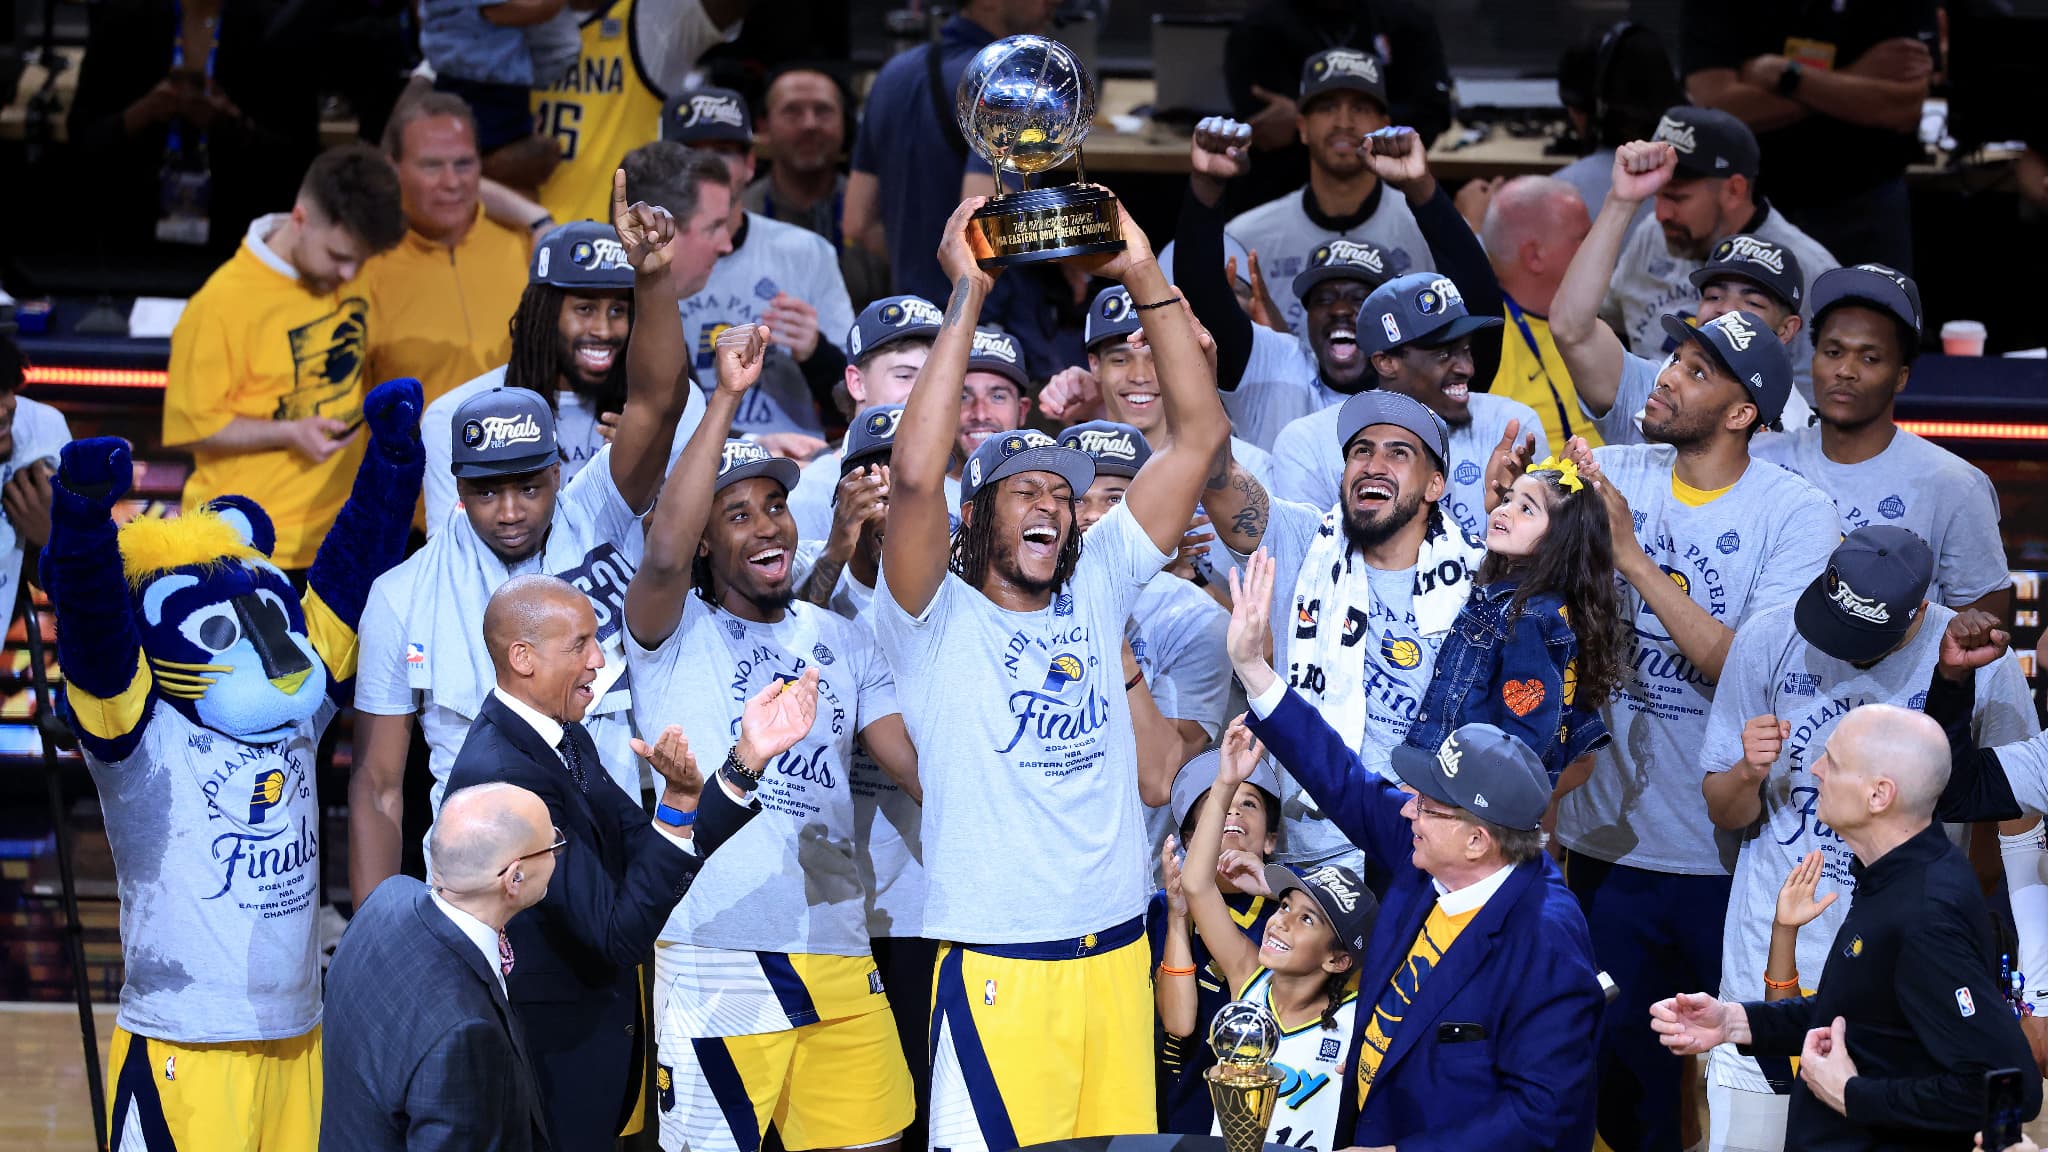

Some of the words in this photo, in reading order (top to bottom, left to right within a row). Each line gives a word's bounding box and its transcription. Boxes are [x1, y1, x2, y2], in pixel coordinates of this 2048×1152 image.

[555, 57, 624, 93] ANA
[1319, 51, 1378, 83] Finals
[684, 94, 743, 128] Finals
[1008, 231, 1038, 245] EASTERN
[1720, 237, 1784, 274] Finals
[1323, 240, 1383, 273] Finals
[476, 413, 541, 451] Finals
[1080, 430, 1136, 460] Finals
[1684, 544, 1726, 619] PACER
[1828, 580, 1891, 624] Finals
[792, 657, 845, 736] PCERS
[1363, 660, 1417, 722] Fin
[1611, 690, 1646, 704] ASTERN
[1657, 685, 1683, 695] 2025
[993, 683, 1109, 754] Finals
[1065, 750, 1082, 759] NBA
[200, 816, 317, 900] Finals
[238, 902, 278, 910] EATERN
[1270, 1062, 1330, 1110] DY
